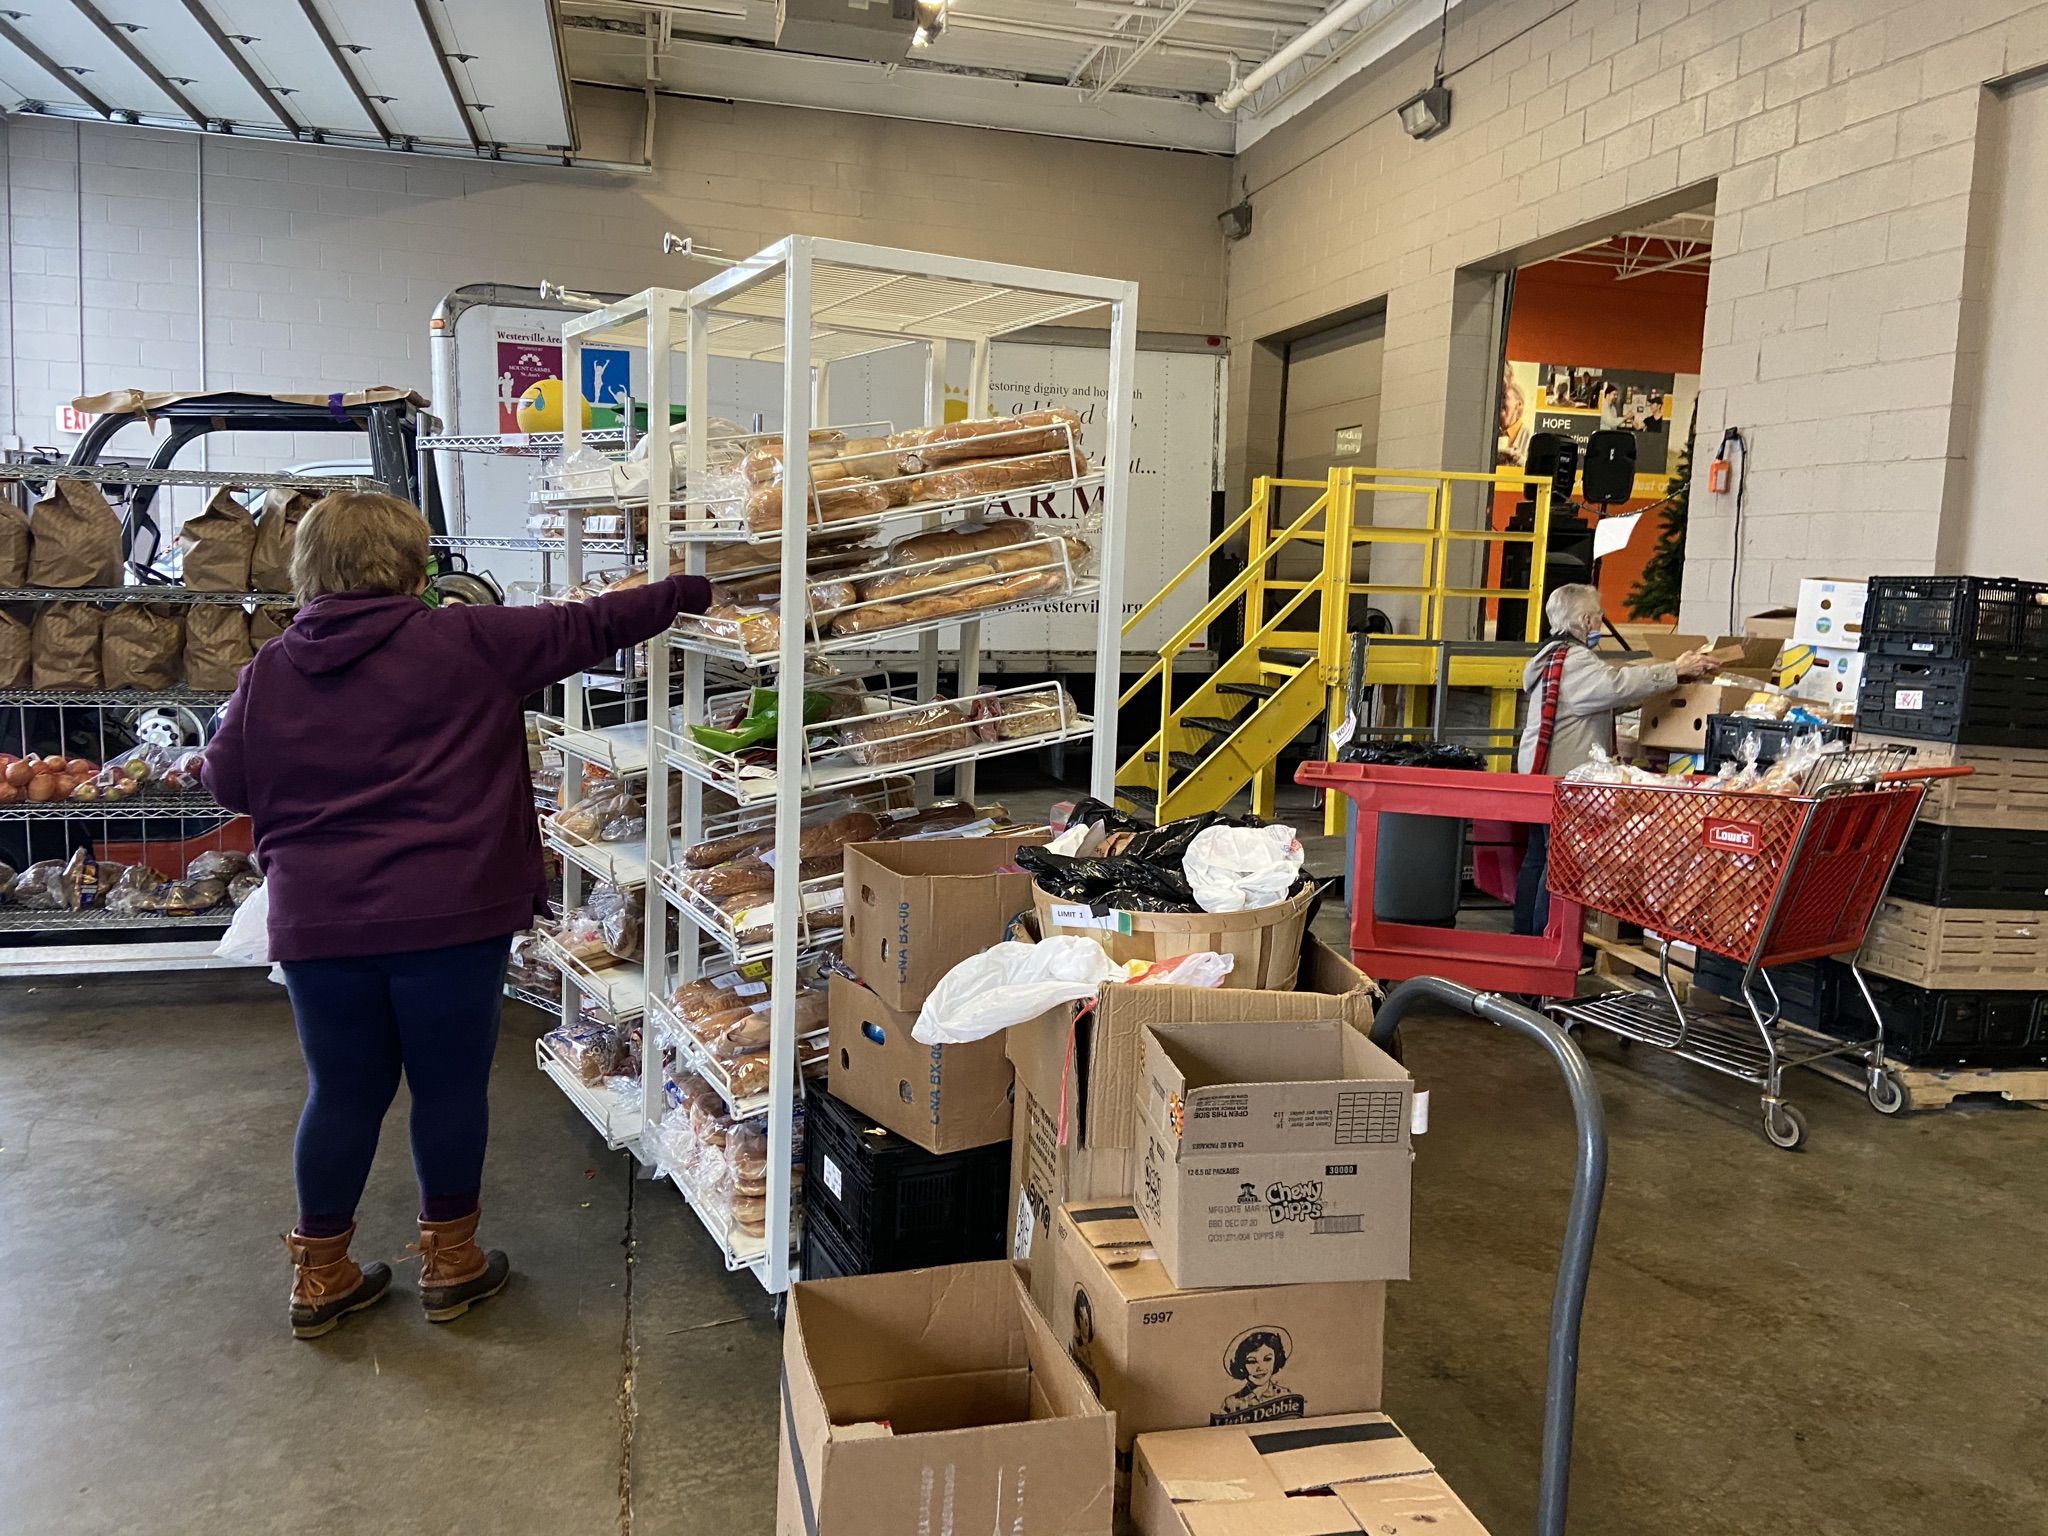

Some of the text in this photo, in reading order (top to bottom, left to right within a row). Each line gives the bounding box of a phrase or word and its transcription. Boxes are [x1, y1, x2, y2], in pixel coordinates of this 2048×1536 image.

[497, 331, 545, 343] Westerville
[988, 382, 1031, 395] estoring
[1033, 382, 1069, 397] dignity
[1072, 385, 1091, 396] and
[1542, 418, 1572, 430] HOPE
[1715, 829, 1750, 844] LOWE'S
[1057, 910, 1084, 919] LIMIT 1
[1212, 1167, 1240, 1175] PACKAGES
[1265, 1180, 1323, 1204] Chewy
[1208, 1206, 1223, 1214] MFG
[1224, 1205, 1242, 1213] DATE
[1268, 1201, 1323, 1224] Dipps
[1225, 1219, 1239, 1227] DEC
[1249, 1219, 1258, 1227] 20
[1253, 1232, 1274, 1240] DIPPS
[1142, 1311, 1174, 1325] 5997
[1253, 1399, 1300, 1421] Debbie
